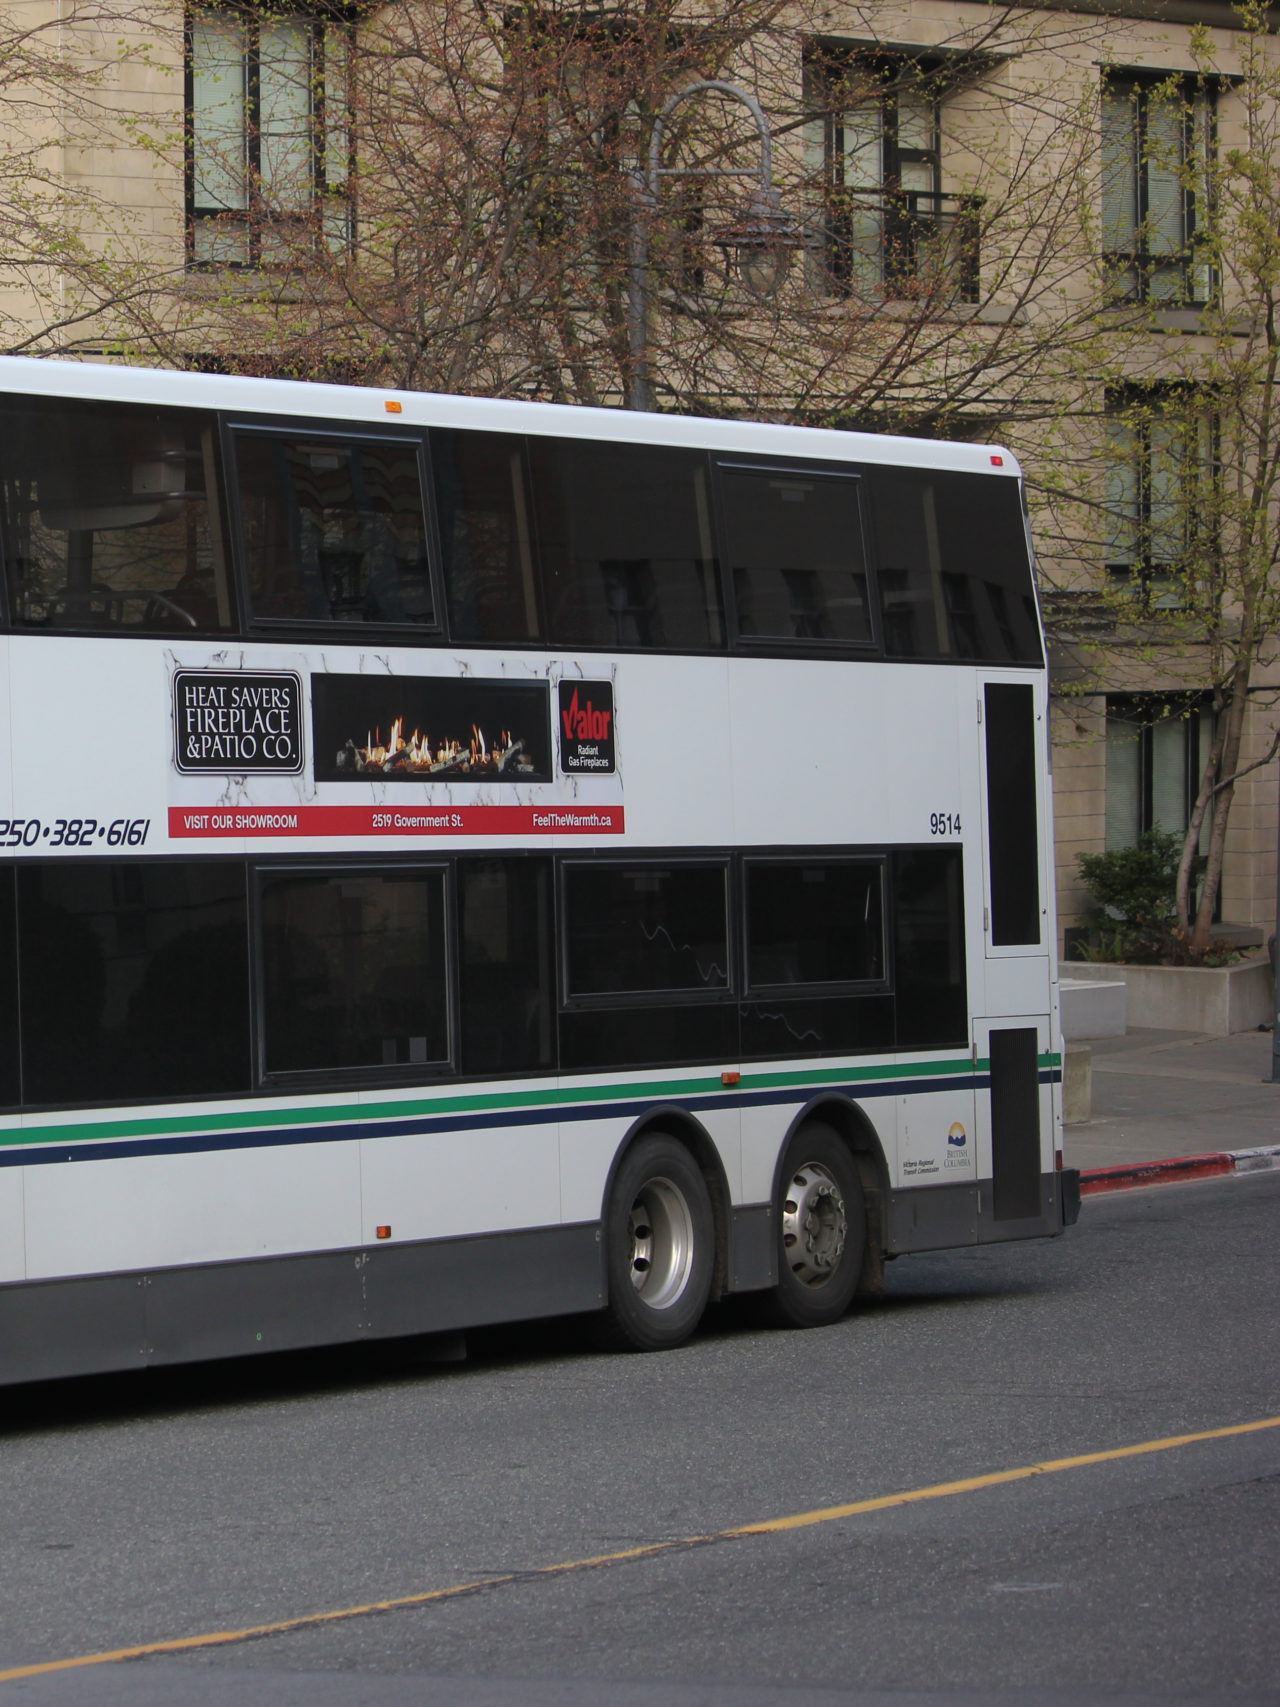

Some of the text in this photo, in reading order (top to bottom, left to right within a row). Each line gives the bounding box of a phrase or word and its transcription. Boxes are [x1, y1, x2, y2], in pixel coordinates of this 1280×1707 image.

[185, 686, 290, 708] HEAT SAVERS
[185, 708, 291, 734] FIREPLACE
[263, 735, 296, 759] CO.
[577, 744, 599, 755] Radiant
[568, 756, 609, 769] Gas Fireplaces
[184, 814, 298, 829] VISIT OUR SHOWROOM
[372, 813, 464, 828] 2519 Government St.
[532, 813, 612, 827] FeelTheWarmth.ca
[930, 813, 962, 835] 9514
